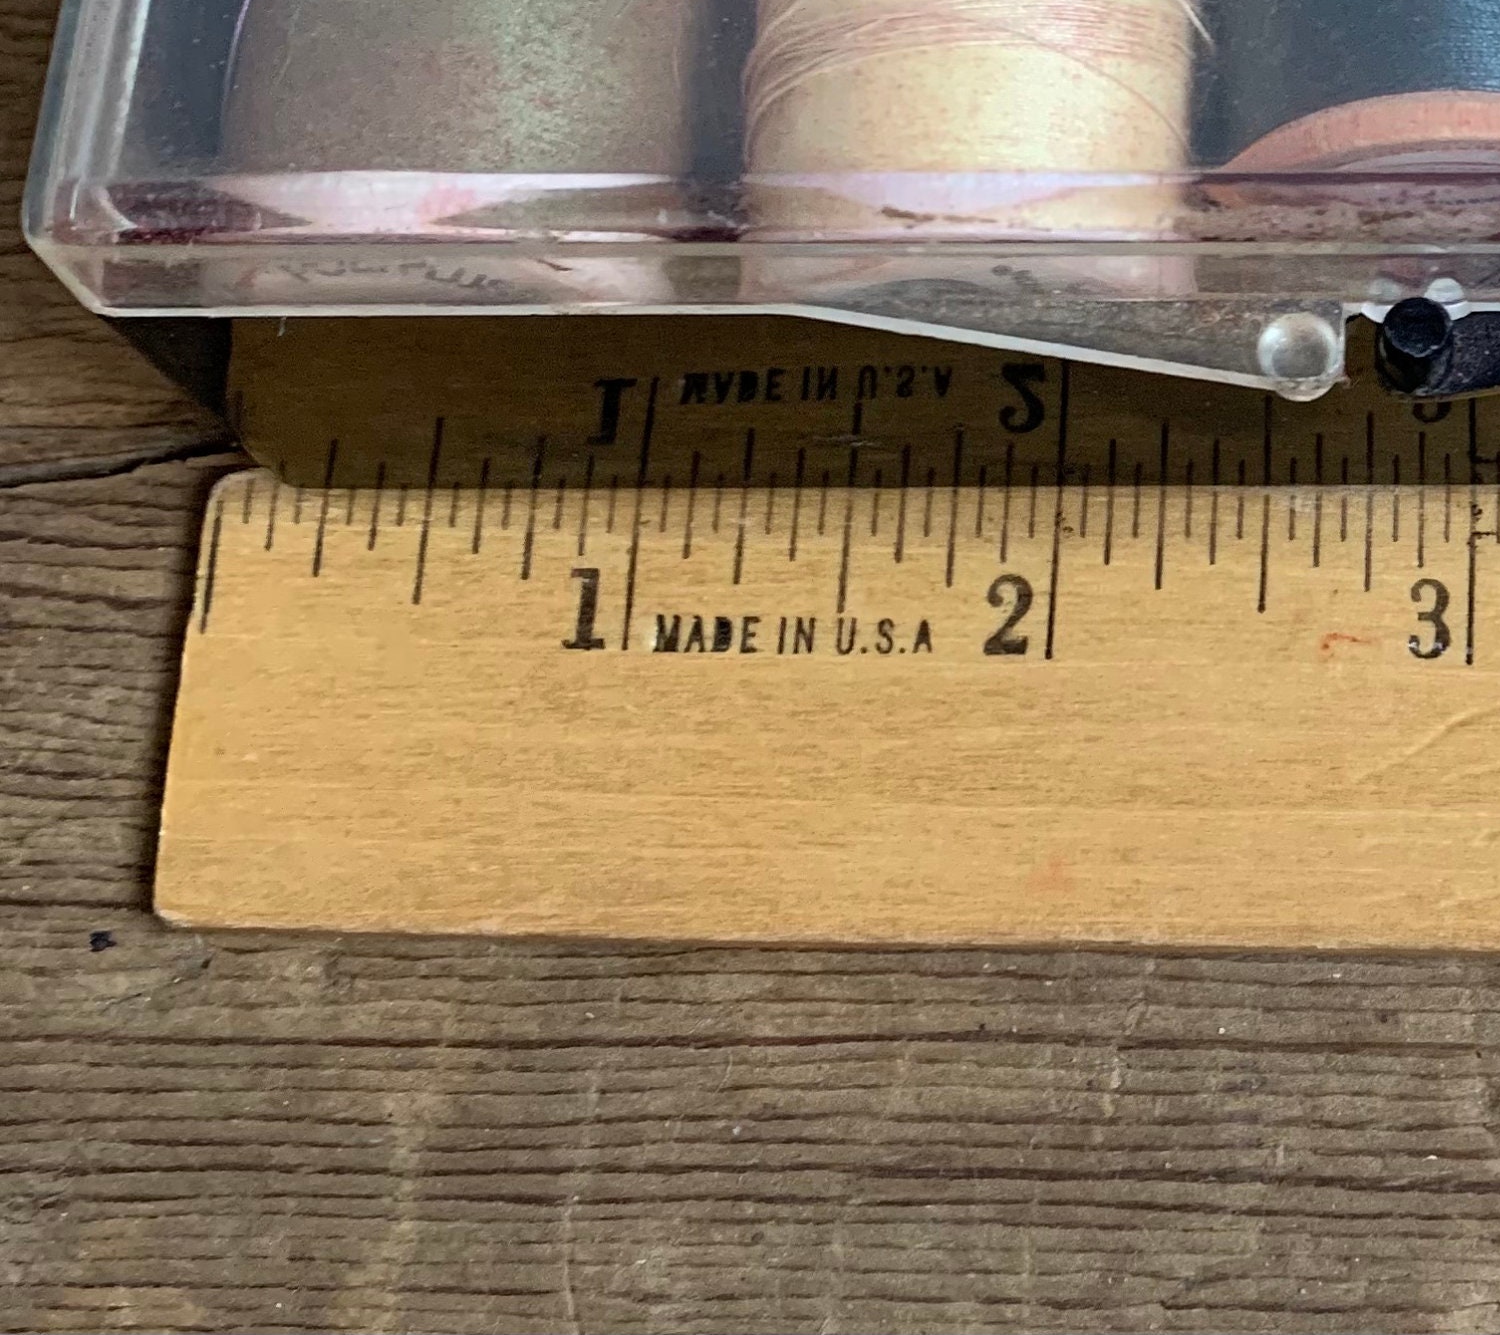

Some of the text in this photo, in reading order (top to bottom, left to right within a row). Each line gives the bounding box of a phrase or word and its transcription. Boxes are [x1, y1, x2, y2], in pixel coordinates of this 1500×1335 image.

[561, 567, 606, 650] 1
[654, 615, 933, 655] MADE IN U.S.A
[983, 574, 1034, 655] 2
[1408, 577, 1452, 660] 3
